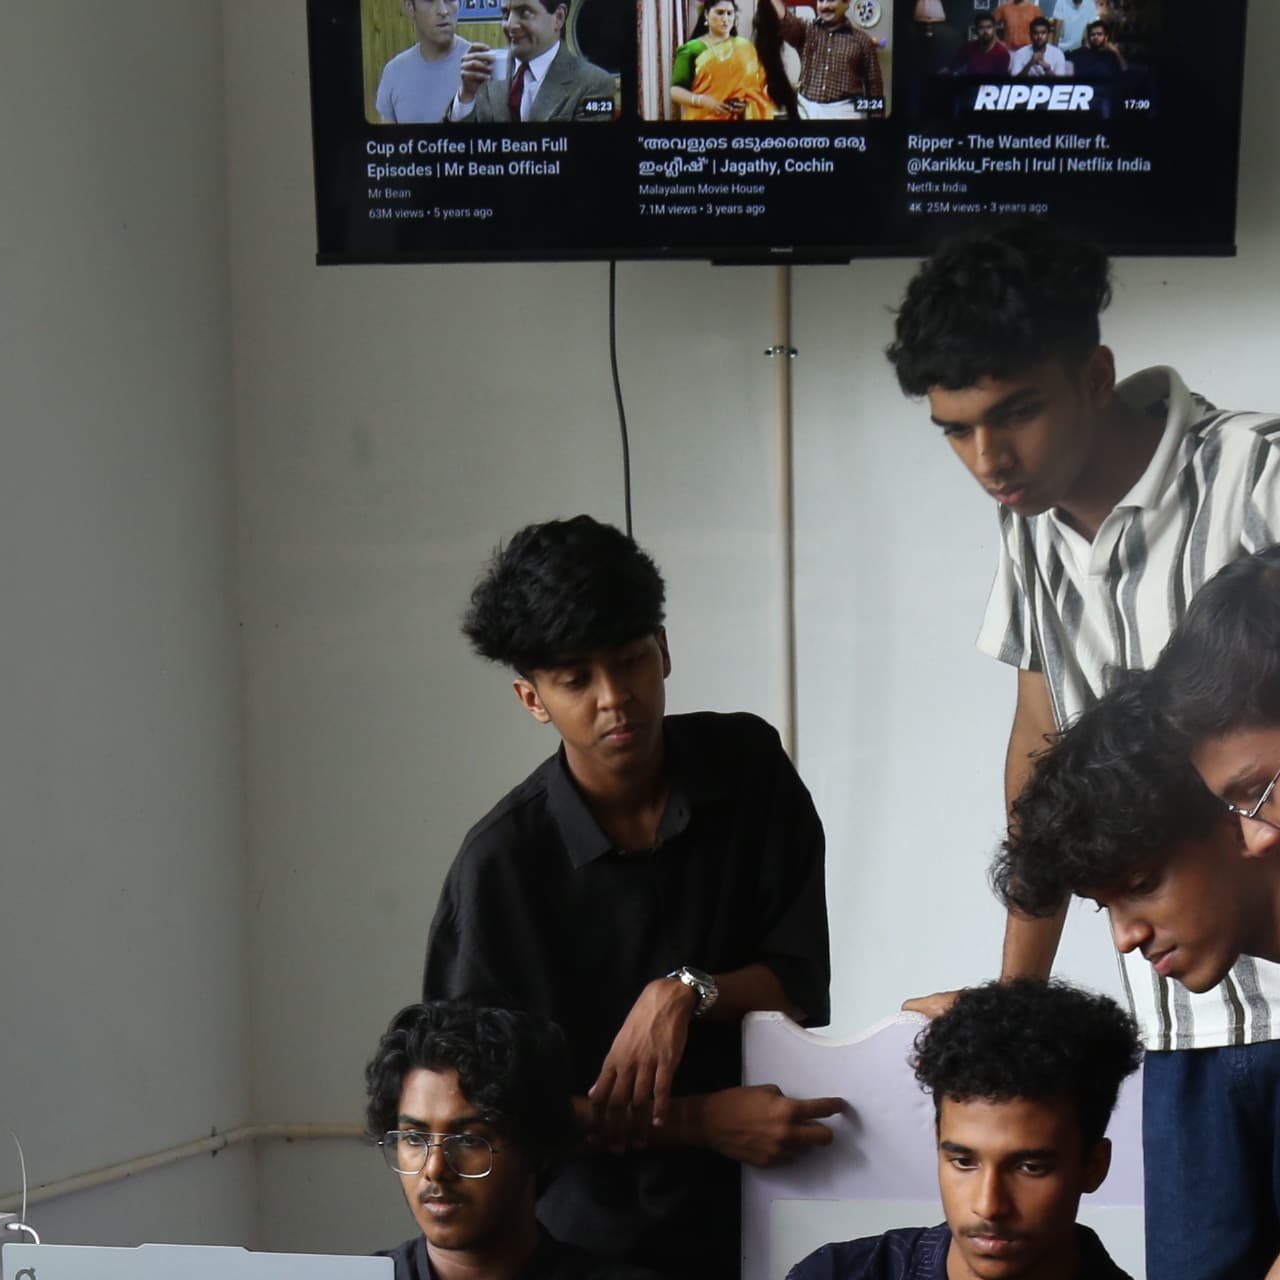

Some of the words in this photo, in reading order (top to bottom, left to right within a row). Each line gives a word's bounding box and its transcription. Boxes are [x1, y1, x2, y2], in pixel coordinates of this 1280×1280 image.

[856, 99, 884, 110] 23:24
[974, 84, 1095, 111] RIPPER
[1124, 99, 1150, 110] 17:00
[585, 101, 613, 112] 48:23
[366, 140, 395, 157] Cup
[399, 139, 414, 154] of
[417, 138, 466, 154] Coffee
[477, 138, 497, 153] Mr
[501, 138, 538, 153] Bean
[541, 137, 568, 152] Full
[907, 135, 954, 152] Ripper
[968, 135, 994, 149] The
[998, 135, 1052, 149] Wanted
[1055, 135, 1092, 149] Killer
[1095, 135, 1110, 149] ft.
[367, 163, 433, 180] Episodes
[444, 162, 465, 176] Mr
[469, 162, 504, 176] Bean
[508, 161, 560, 175] Official
[721, 158, 781, 176] Jagathy,
[784, 158, 834, 173] Cochin
[907, 157, 1021, 175] @Karikku_Fresh
[1033, 157, 1056, 172] Irul
[1067, 157, 1113, 172] Netflix
[1117, 157, 1152, 172] India
[368, 188, 382, 199] Mr
[385, 188, 412, 199] Bean
[639, 184, 696, 197] Malayalam
[697, 183, 730, 195] Movie
[731, 183, 766, 194] House
[907, 182, 940, 193] Netflix
[942, 182, 968, 193] India
[369, 208, 393, 219] 63M
[395, 208, 425, 219] views
[434, 207, 441, 218] 5
[443, 208, 471, 220] years
[473, 208, 494, 220] ago
[639, 204, 666, 215] 7.1M
[668, 204, 697, 215] views
[706, 203, 713, 214] 3
[715, 204, 744, 217] years
[745, 204, 766, 216] ago
[926, 202, 950, 213] 25M
[952, 202, 981, 213] views
[989, 202, 997, 212] 3
[998, 203, 1026, 215] years
[1029, 203, 1048, 215] ago
